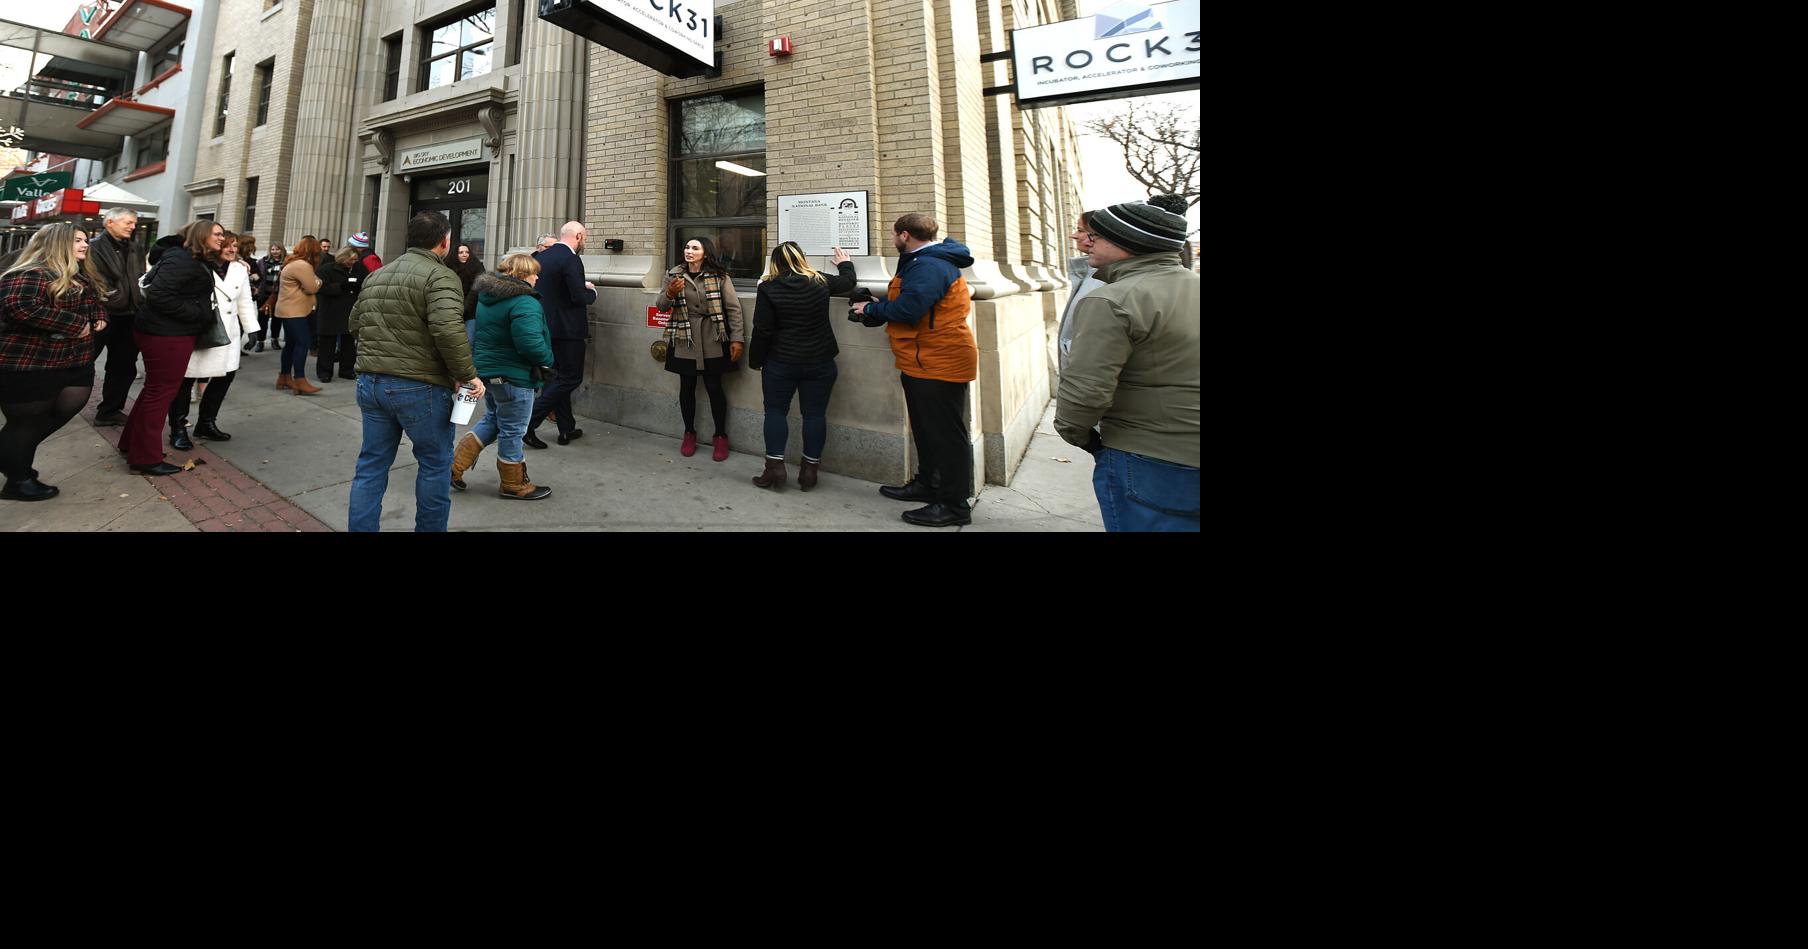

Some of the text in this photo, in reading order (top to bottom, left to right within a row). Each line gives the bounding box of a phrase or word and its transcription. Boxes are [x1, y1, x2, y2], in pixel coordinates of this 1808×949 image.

[1082, 67, 1138, 80] ACCELERATOR
[412, 149, 478, 165] ECONOMIC DEVELOPMENT
[16, 187, 52, 198] Valle
[447, 180, 471, 194] 201
